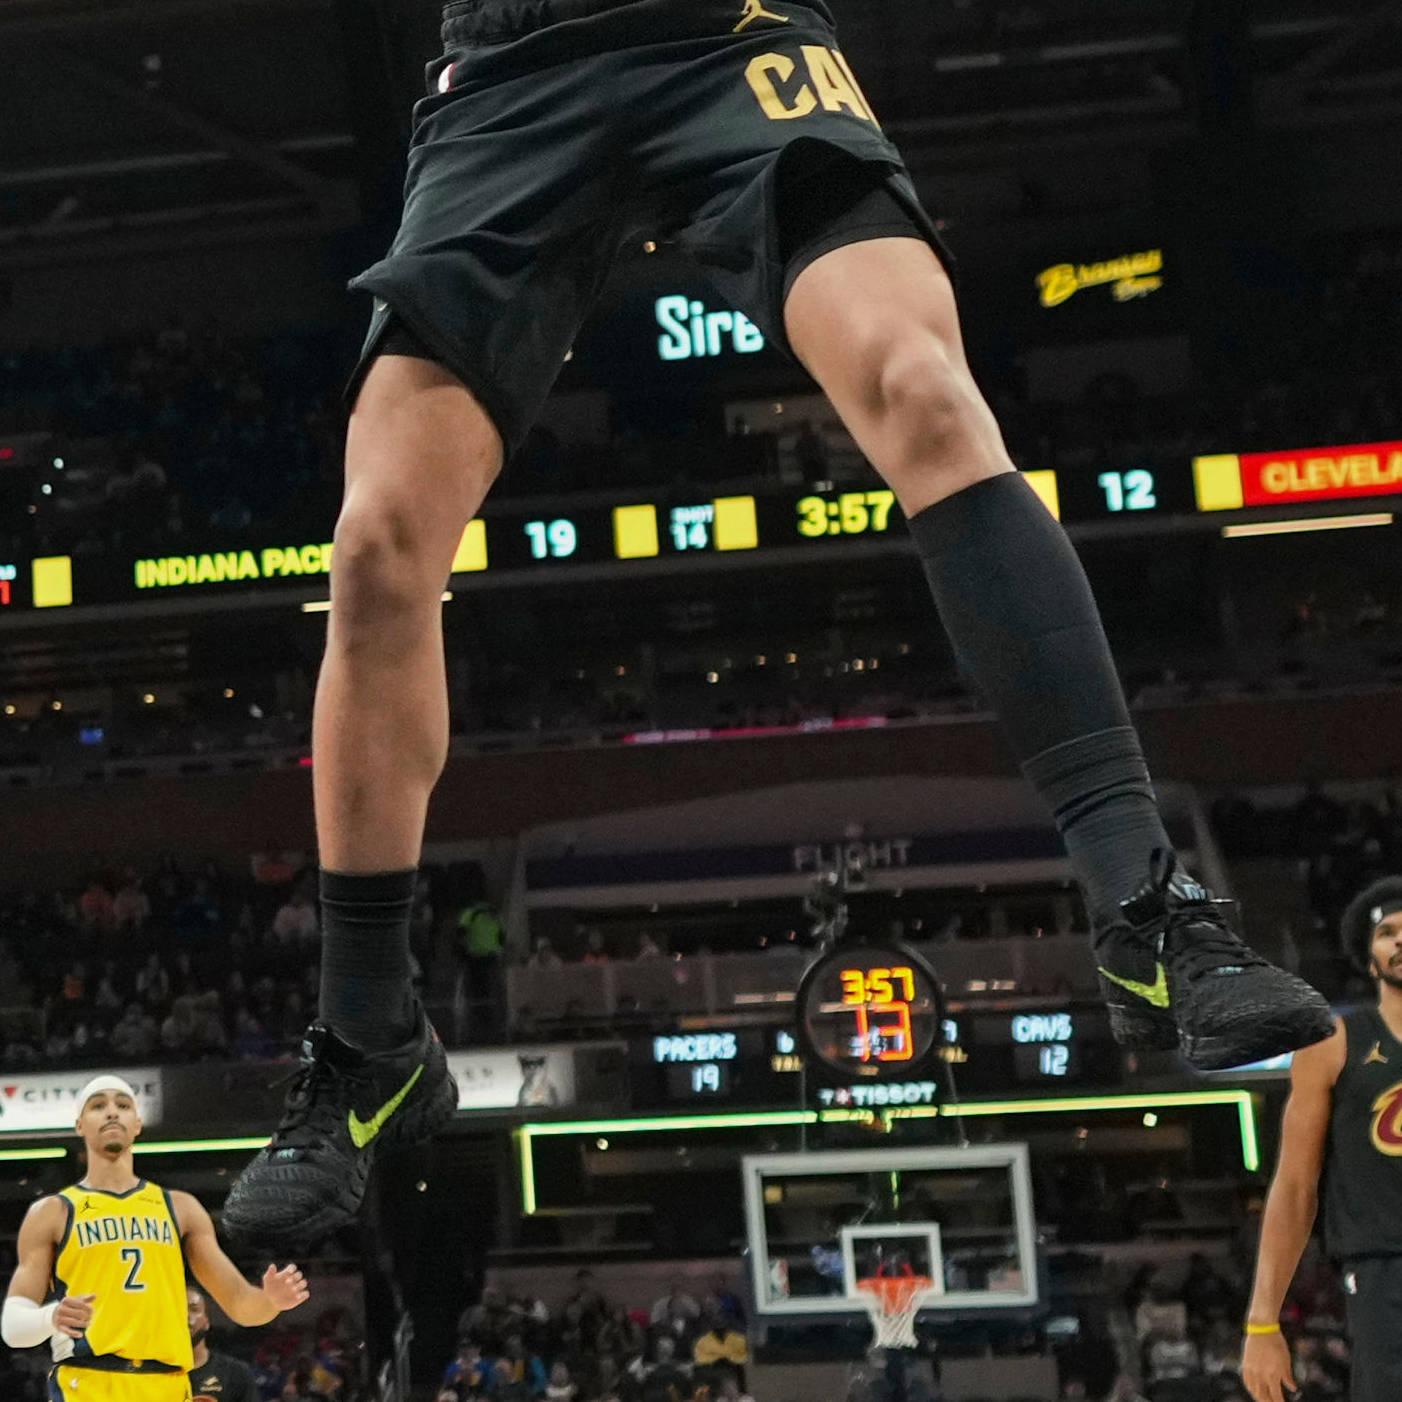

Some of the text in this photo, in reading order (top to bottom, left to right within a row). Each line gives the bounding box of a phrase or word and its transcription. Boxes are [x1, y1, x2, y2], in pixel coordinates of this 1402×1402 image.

[744, 44, 883, 132] CA
[1099, 469, 1156, 512] 12
[671, 503, 715, 526] SHOT
[796, 488, 897, 539] 3:57
[524, 518, 577, 560] 19
[671, 522, 708, 552] 14
[134, 542, 334, 589] INDIANA PACE
[839, 966, 915, 1005] 3:57
[856, 1000, 914, 1063] 13
[1011, 1012, 1073, 1043] CAVS
[654, 1032, 737, 1063] PACERS
[1038, 1044, 1069, 1076] 12
[691, 1063, 720, 1092] 19
[851, 1080, 937, 1107] TISSOT
[76, 1216, 175, 1248] INDIANA
[121, 1247, 146, 1292] 2
